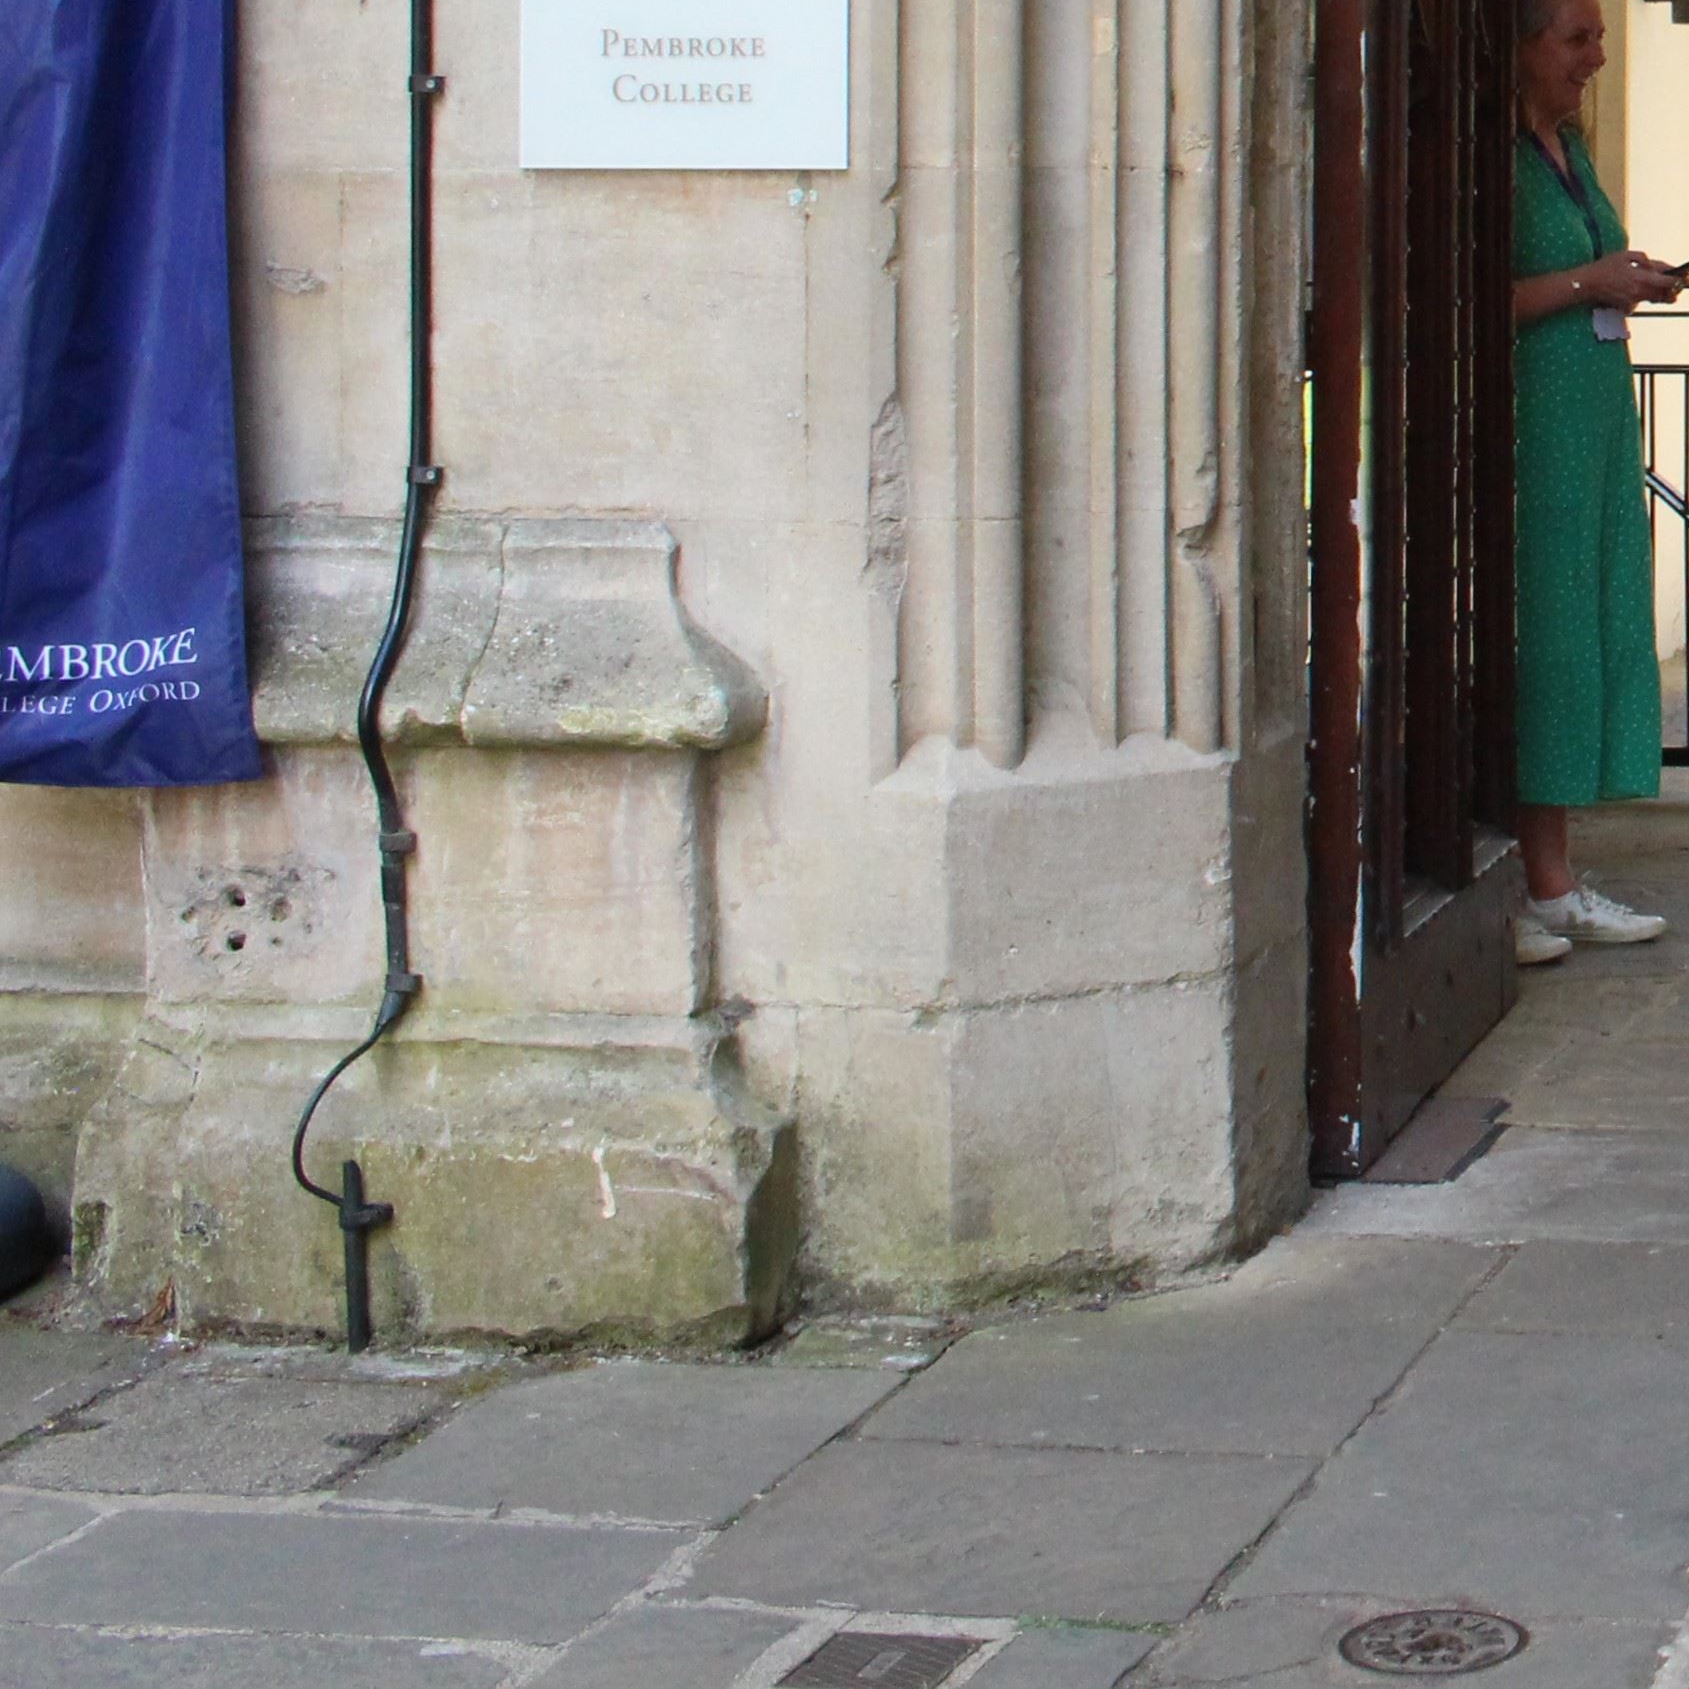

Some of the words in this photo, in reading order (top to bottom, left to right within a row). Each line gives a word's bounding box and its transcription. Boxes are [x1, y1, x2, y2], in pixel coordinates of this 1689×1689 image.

[599, 28, 766, 59] PEMBROKE
[611, 73, 754, 105] COLLEGE
[0, 627, 198, 682] MBROKE
[89, 680, 200, 713] OXFORD
